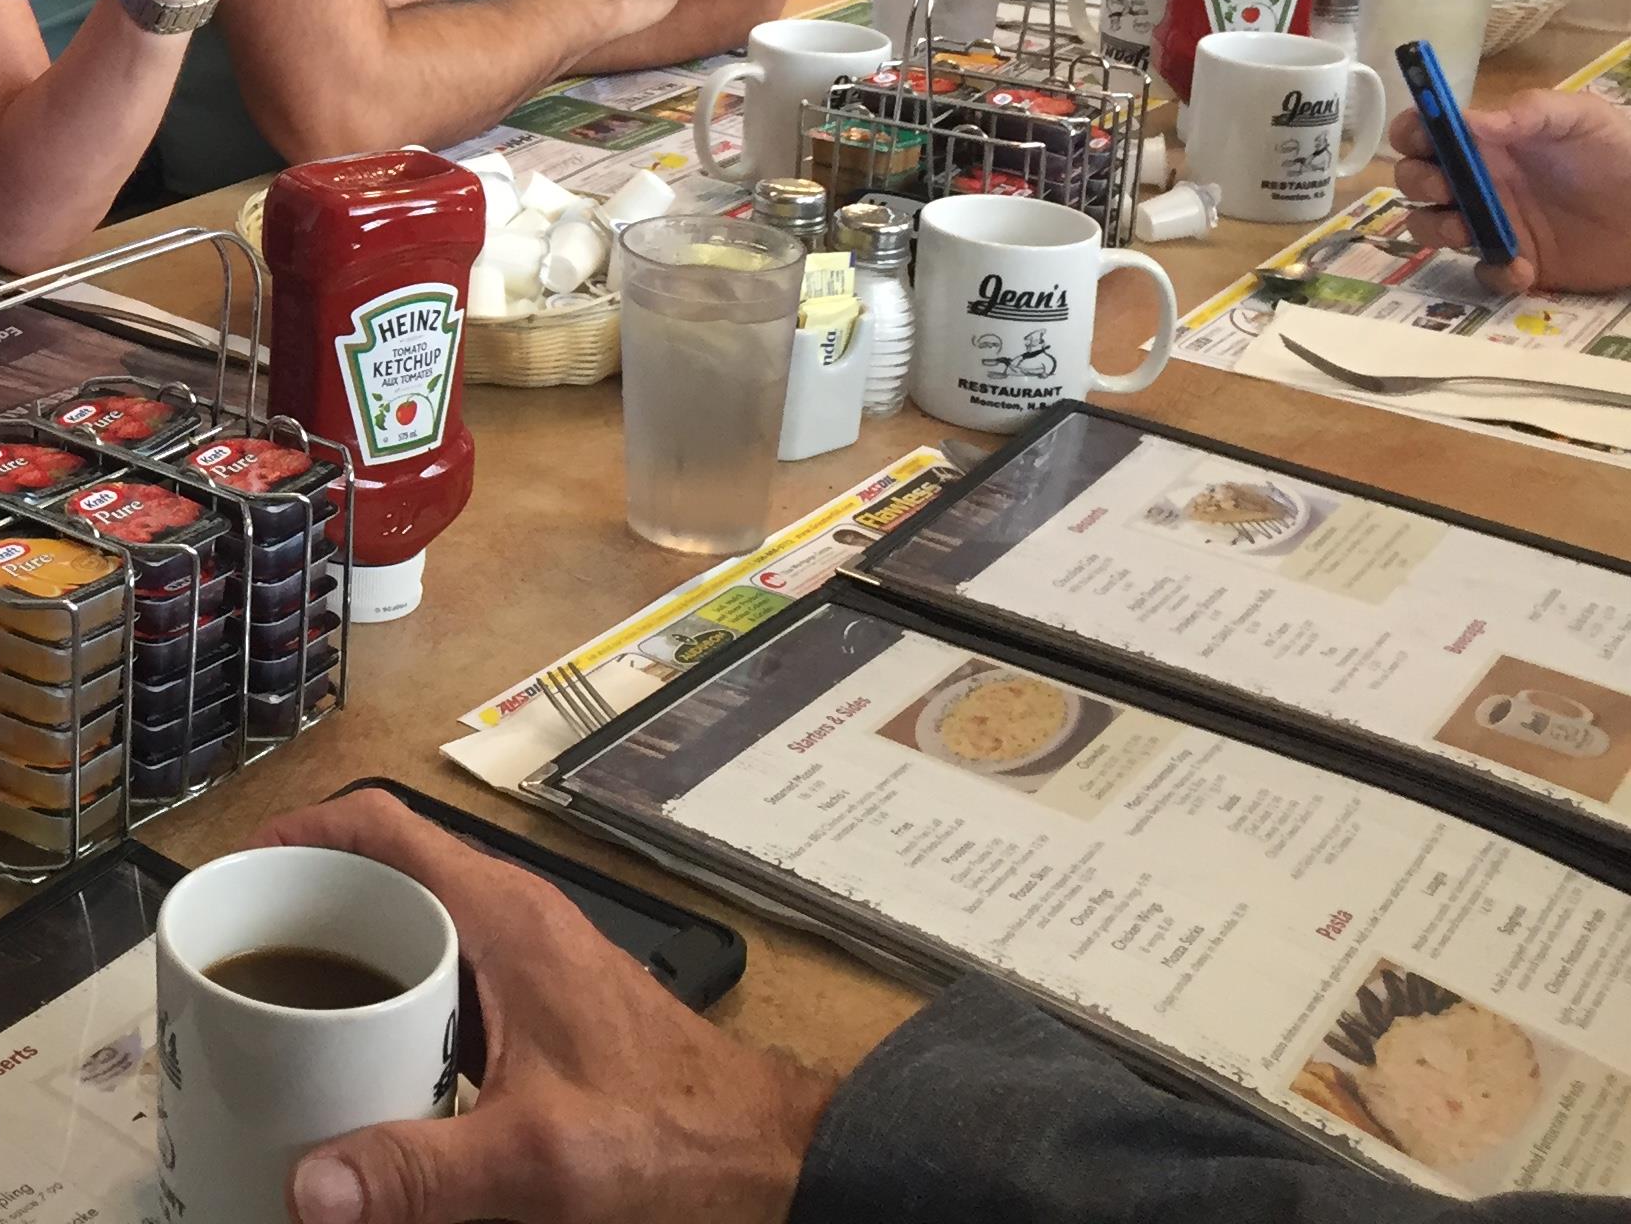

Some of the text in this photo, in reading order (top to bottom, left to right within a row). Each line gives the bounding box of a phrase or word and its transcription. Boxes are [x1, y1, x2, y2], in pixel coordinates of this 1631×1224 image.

[967, 274, 1069, 322] Jean's
[378, 309, 441, 343] HEINZ
[393, 342, 427, 357] TOMATO
[373, 348, 441, 378] KETCHUP
[958, 378, 1063, 398] RESTAURANT
[68, 406, 94, 422] Kraft
[199, 448, 229, 465] Kraft
[210, 453, 258, 478] Pure
[84, 492, 115, 509] Kraft
[93, 499, 144, 526] Pure
[857, 474, 941, 534] Flawless
[2, 552, 56, 577] Pure
[786, 722, 838, 753] Starters
[834, 695, 872, 717] Sides
[1315, 907, 1354, 944] Pasta
